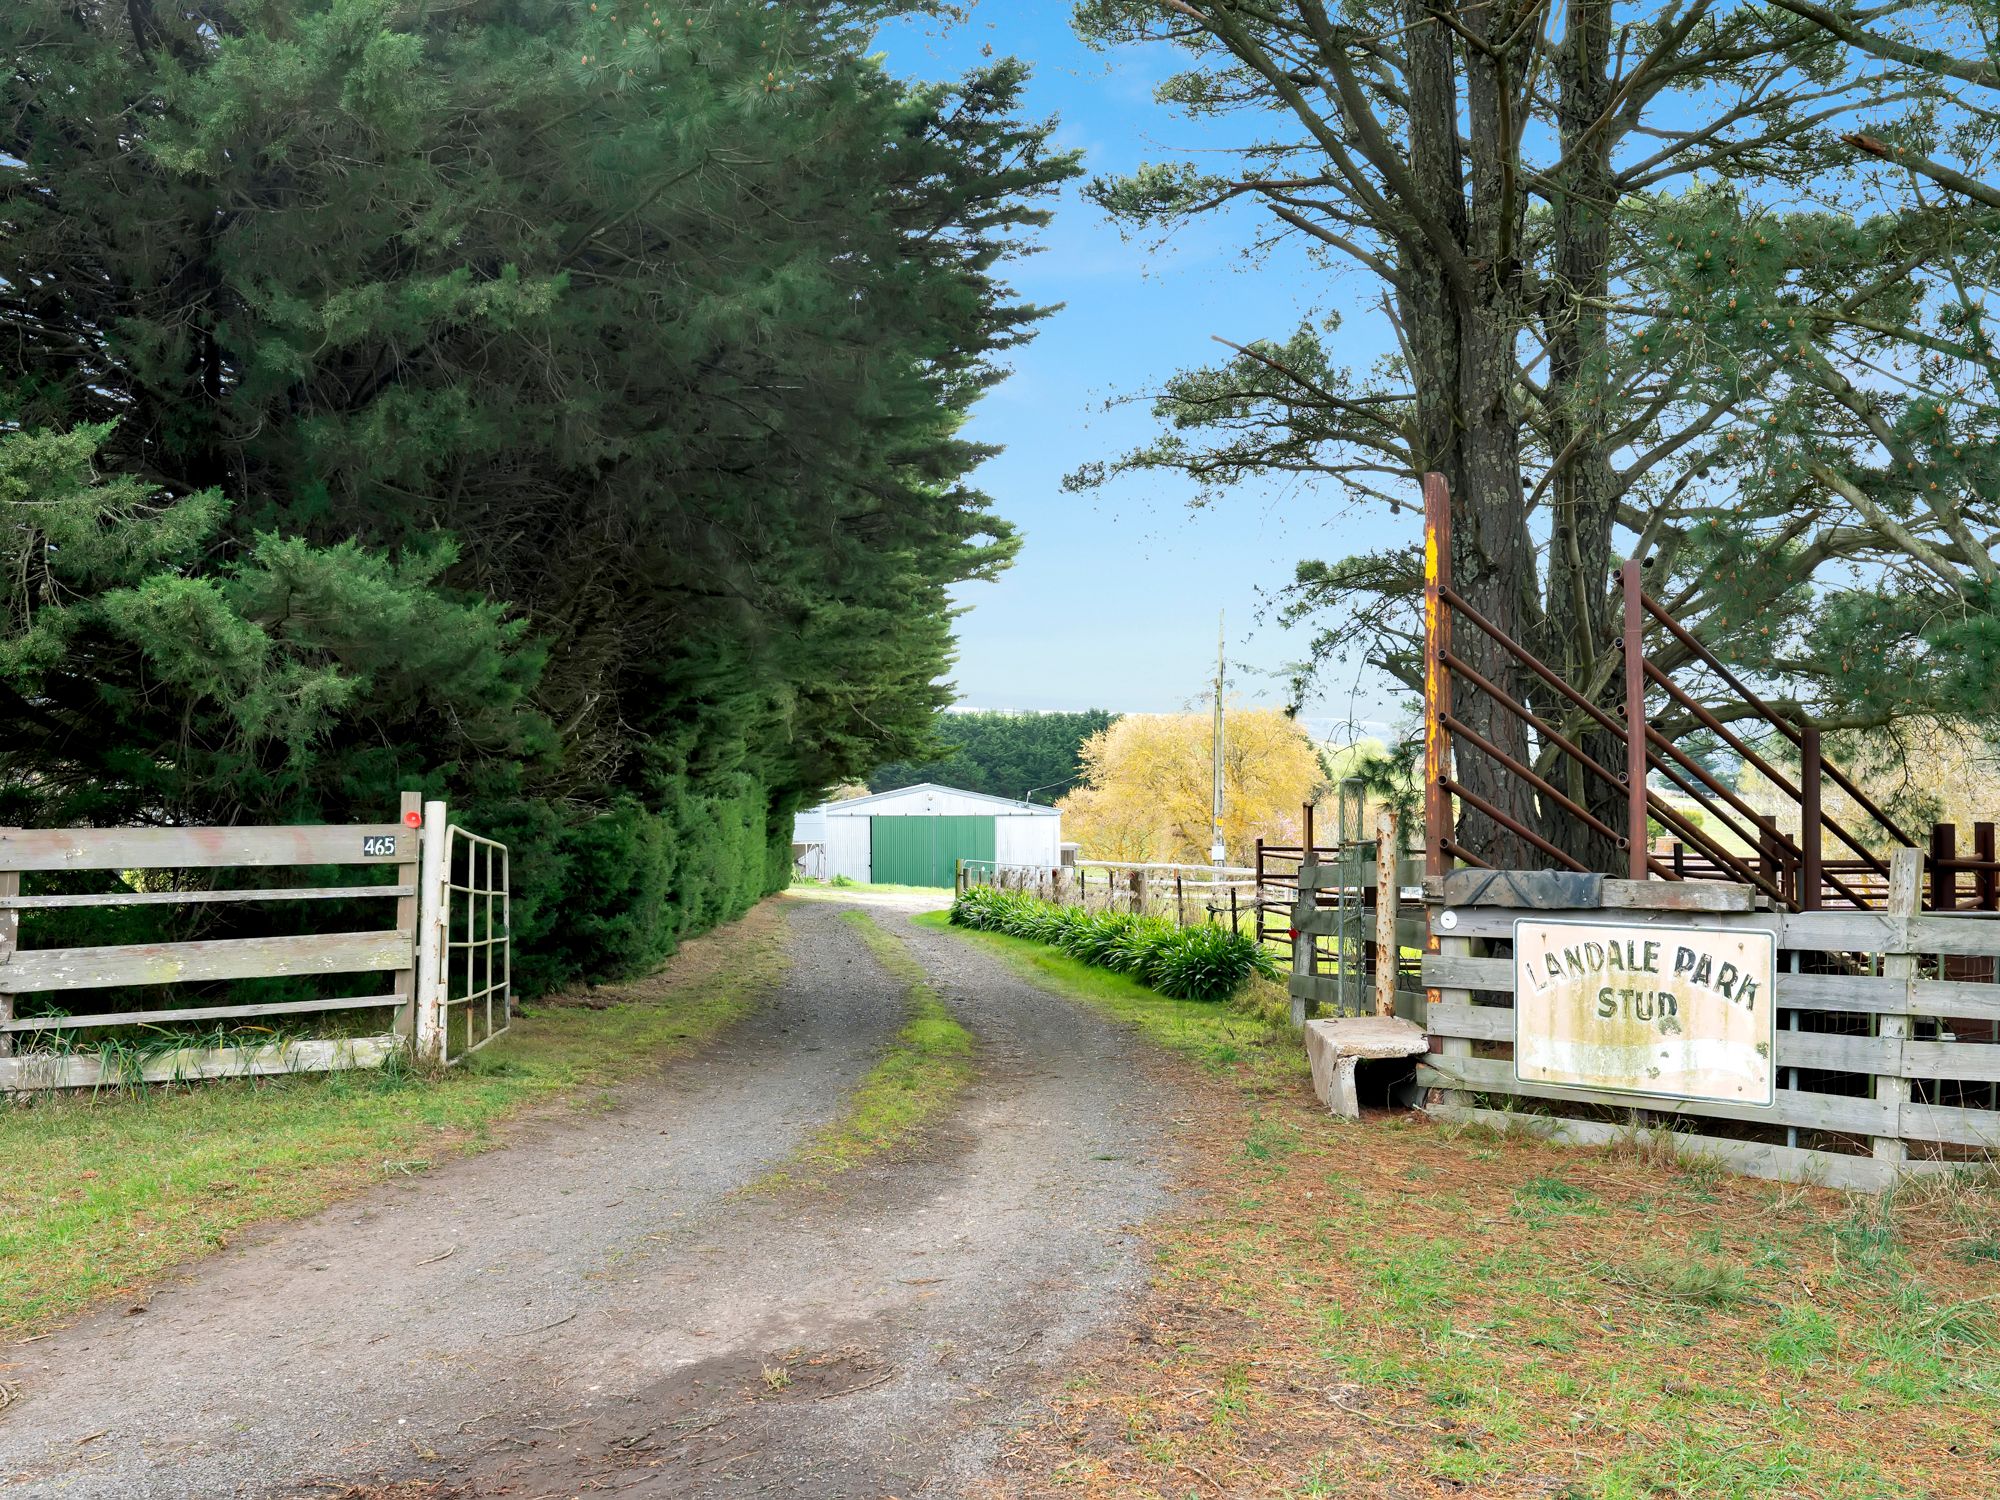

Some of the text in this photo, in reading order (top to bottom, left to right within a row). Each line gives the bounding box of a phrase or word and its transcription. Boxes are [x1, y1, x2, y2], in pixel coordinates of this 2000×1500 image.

[364, 837, 395, 855] 465
[1526, 939, 1760, 1011] LANDALE PARK
[1598, 987, 1678, 1021] STUD
